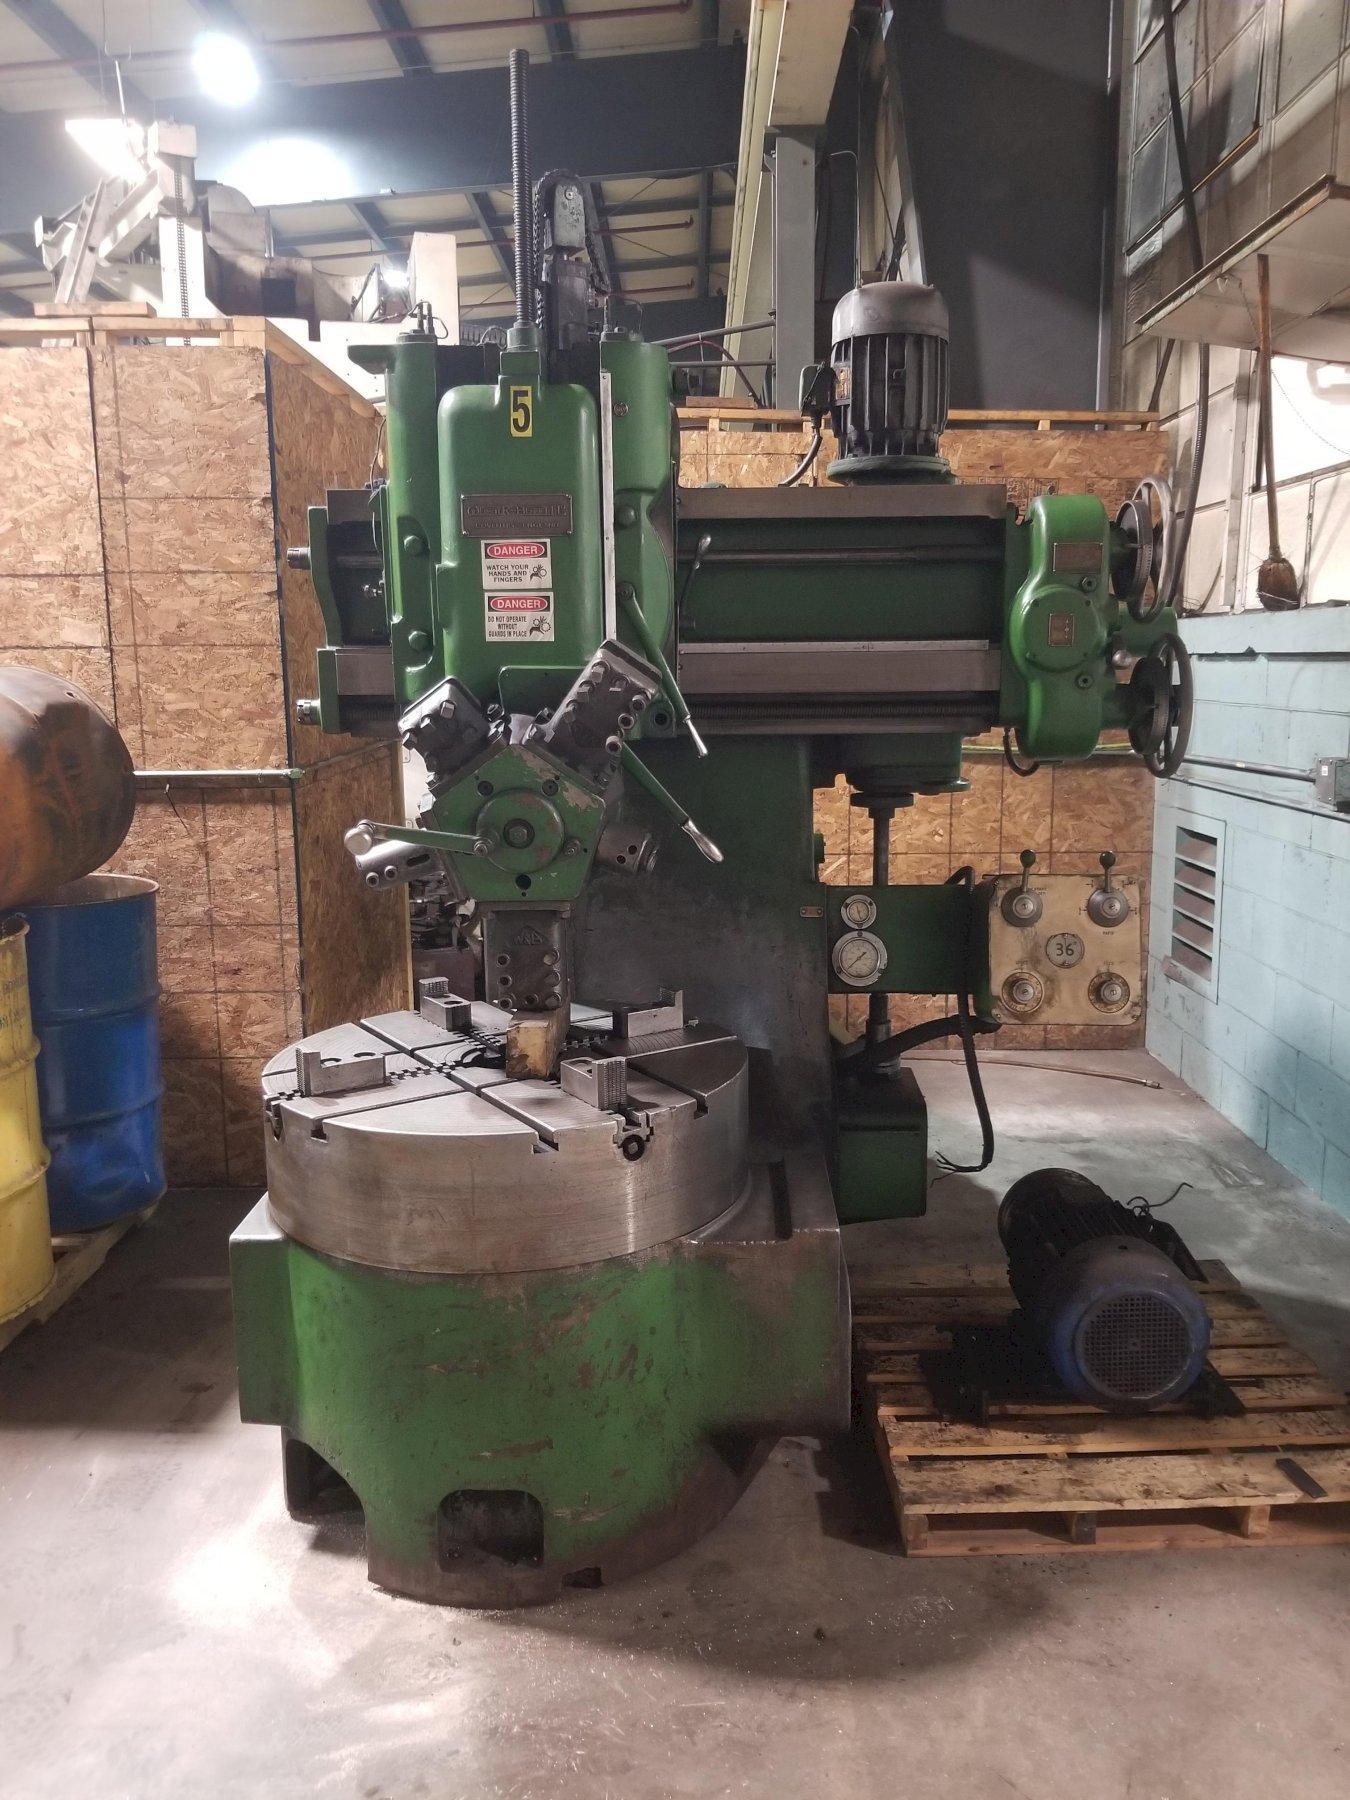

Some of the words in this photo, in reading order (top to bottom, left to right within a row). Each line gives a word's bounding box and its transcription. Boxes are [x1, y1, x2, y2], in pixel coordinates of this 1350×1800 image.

[513, 390, 530, 433] 5
[494, 546, 538, 555] DANGER
[497, 600, 541, 608] DANGER
